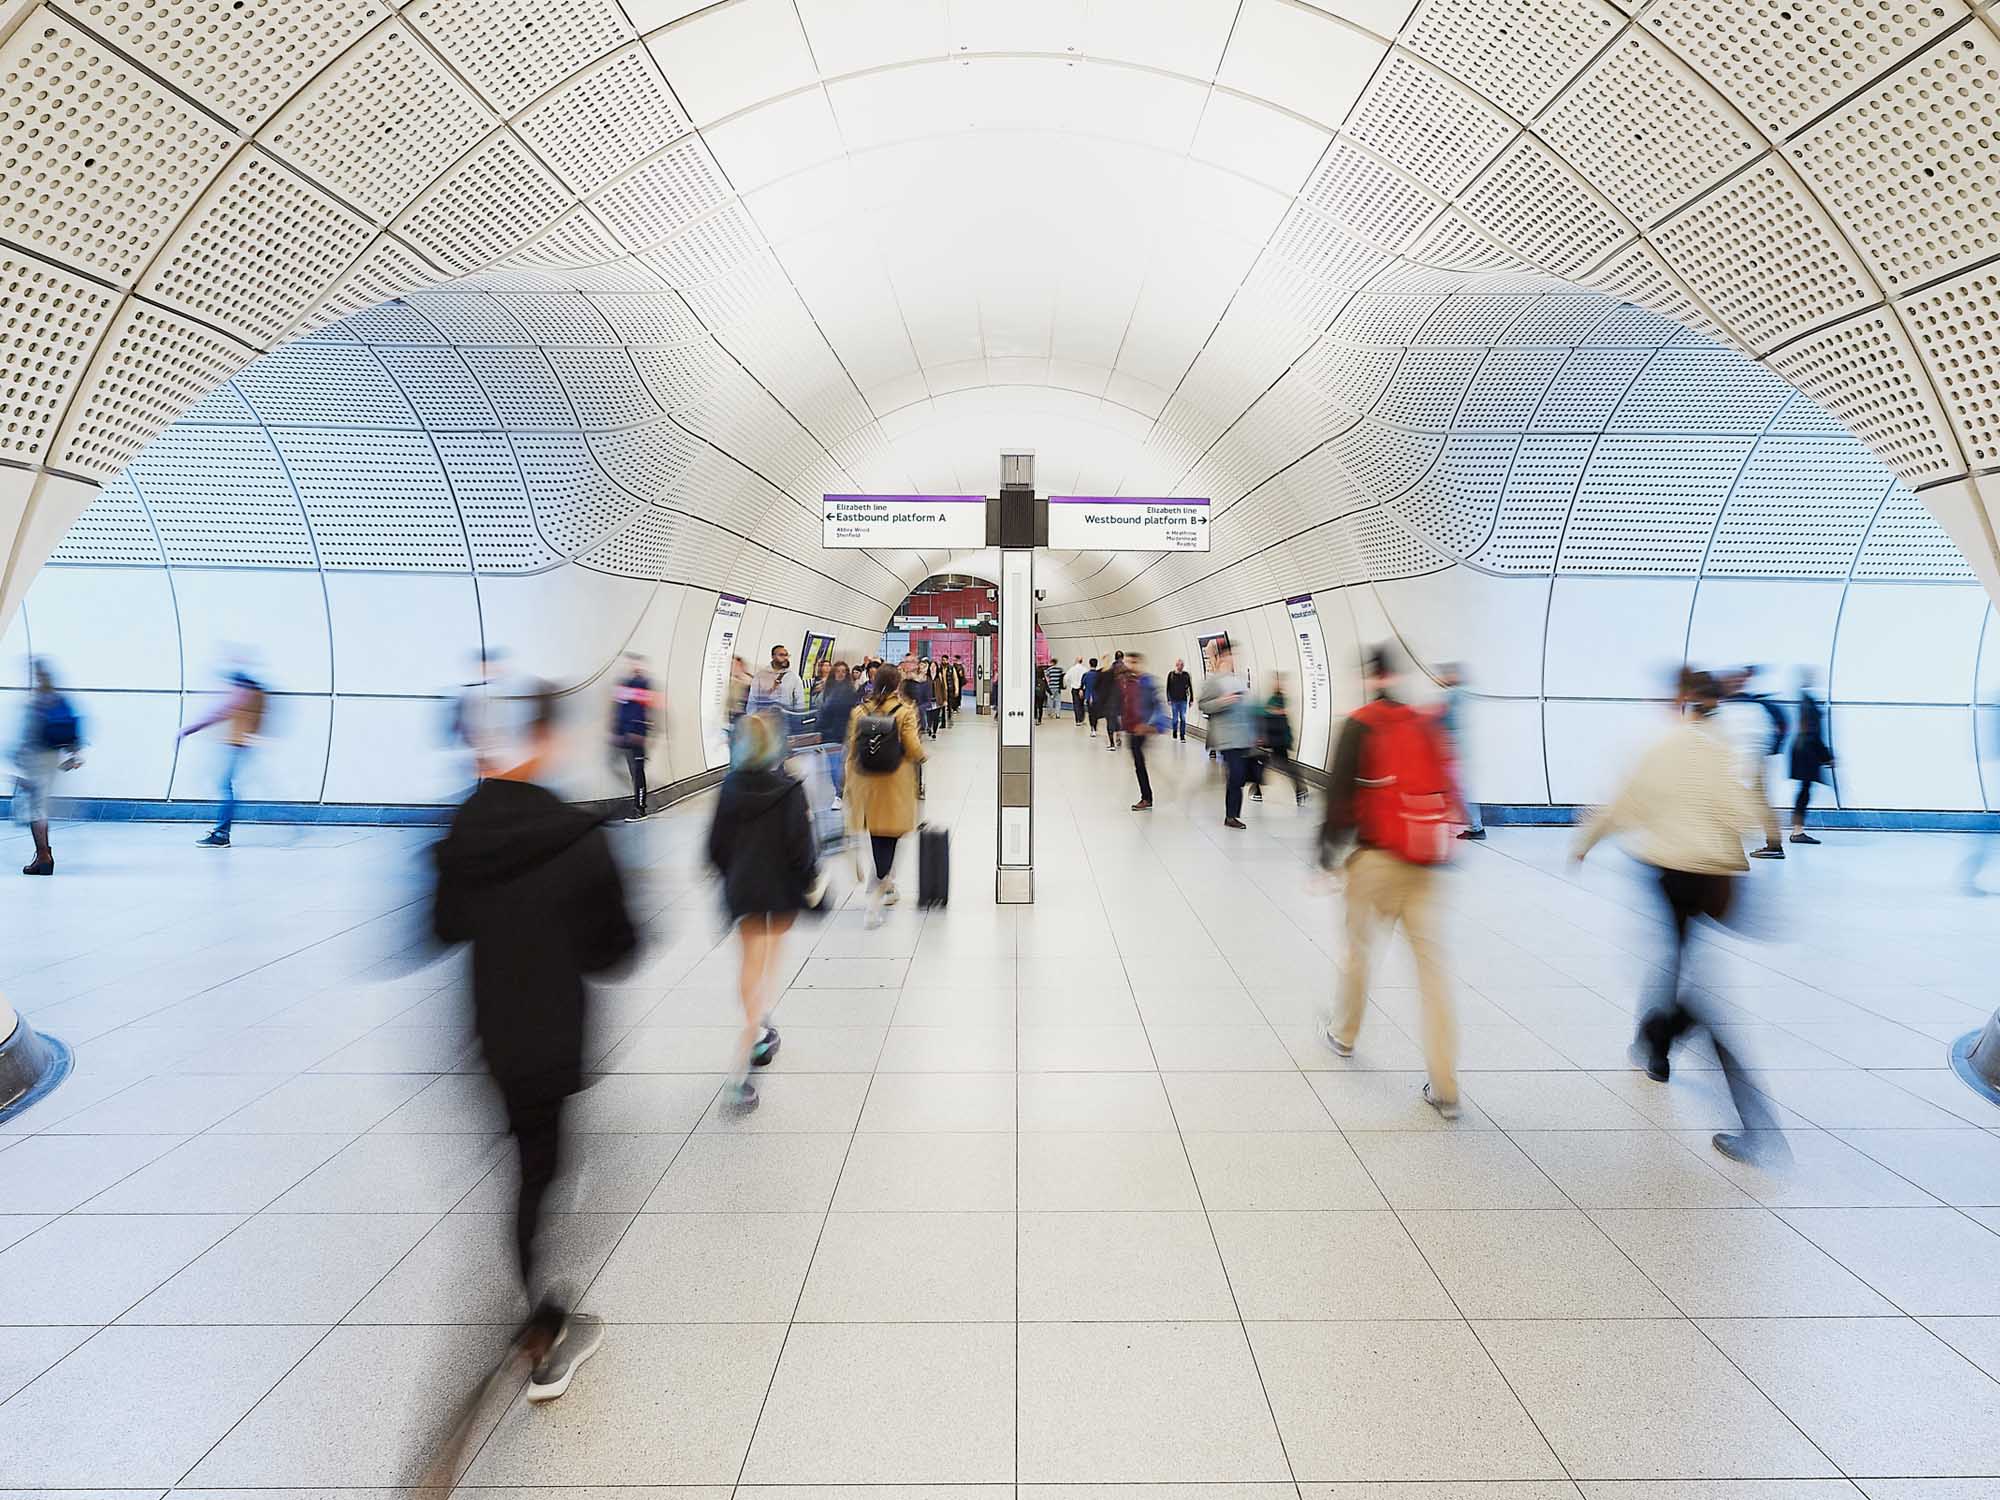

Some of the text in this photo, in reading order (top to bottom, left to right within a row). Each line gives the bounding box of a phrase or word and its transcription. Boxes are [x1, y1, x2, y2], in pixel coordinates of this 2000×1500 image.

[836, 503, 871, 511] Elizabeth
[1146, 506, 1183, 514] Elizabeth
[836, 512, 947, 524] Eastbound platform A
[1084, 514, 1197, 526] Westbound platform B
